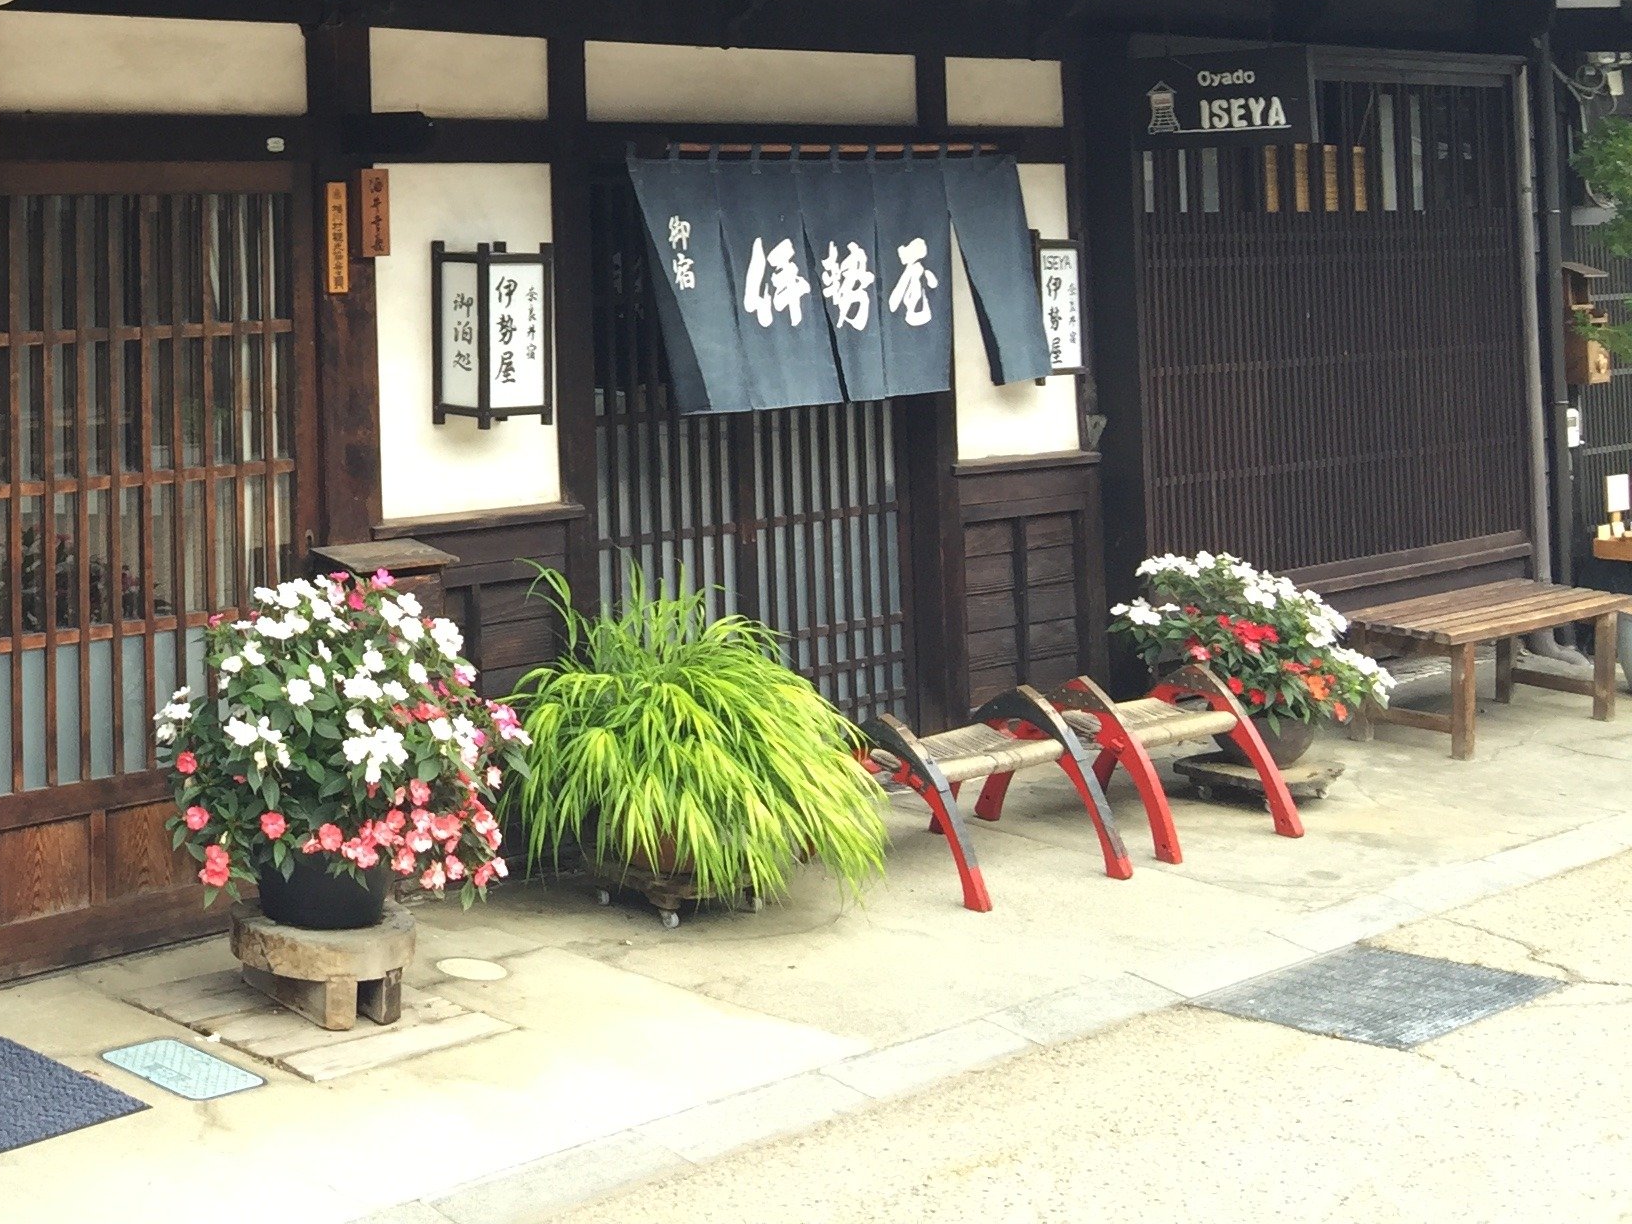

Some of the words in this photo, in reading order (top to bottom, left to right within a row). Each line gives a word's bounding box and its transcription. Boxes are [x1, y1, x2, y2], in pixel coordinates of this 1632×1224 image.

[1197, 69, 1256, 87] Oyado
[1200, 96, 1287, 129] ISEYA
[667, 215, 696, 291] 御宿
[743, 235, 939, 331] 伊勢屋
[495, 276, 519, 384] 伊勢屋
[1046, 275, 1063, 365] 伊勢屋
